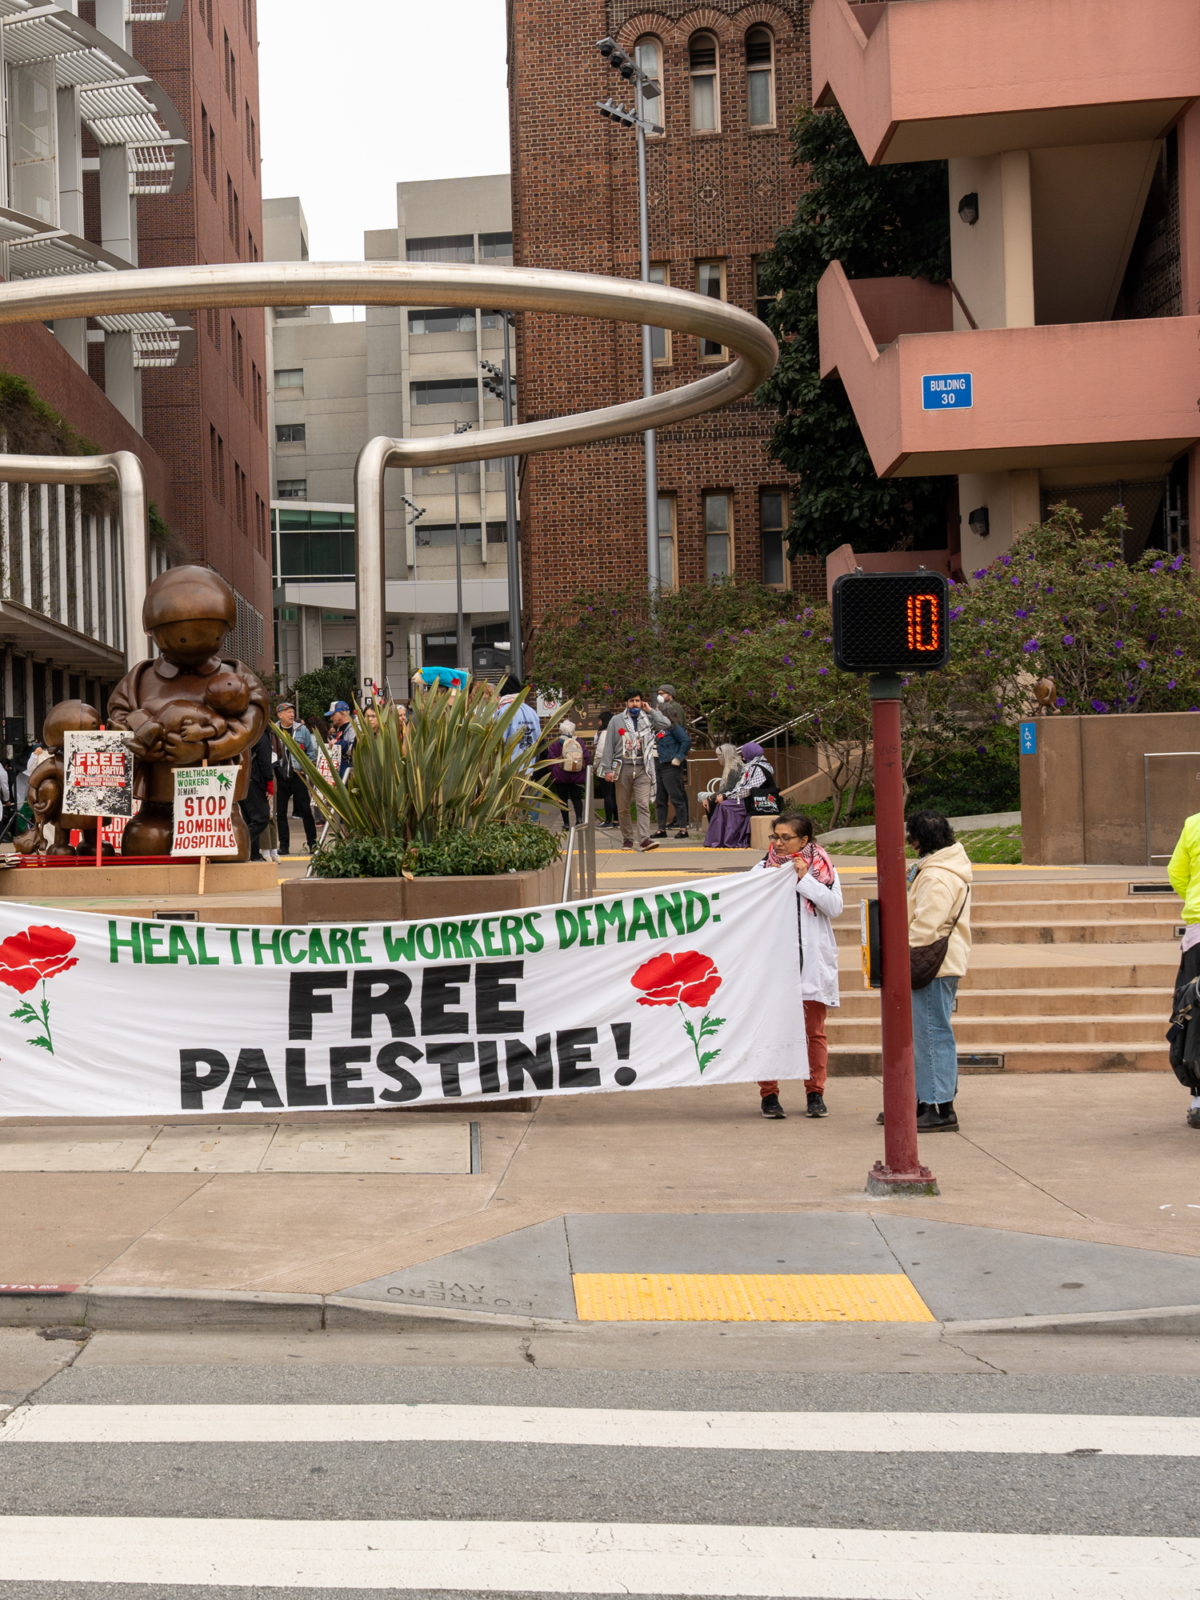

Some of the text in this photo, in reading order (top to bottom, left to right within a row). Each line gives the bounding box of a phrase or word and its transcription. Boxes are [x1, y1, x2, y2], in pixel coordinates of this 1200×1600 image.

[930, 378, 966, 391] BUILDING
[941, 393, 955, 404] 30
[906, 593, 939, 651] 10
[76, 753, 123, 766] FREE
[75, 765, 125, 775] DR. ABU SAFIYA
[177, 769, 217, 778] HEALTHCARE
[177, 778, 209, 787] WORKERS
[178, 787, 199, 796] DEMAND:
[184, 796, 227, 817] STOP
[177, 817, 232, 835] BOMBING
[174, 833, 236, 850] HOSPITALS
[109, 889, 721, 965] HEALTHCARE WORKERS DEMAND:
[288, 960, 525, 1041] FREE
[180, 1022, 636, 1111] PALESTINE!
[427, 1279, 485, 1293] AVE
[386, 1286, 533, 1310] POTRERO
